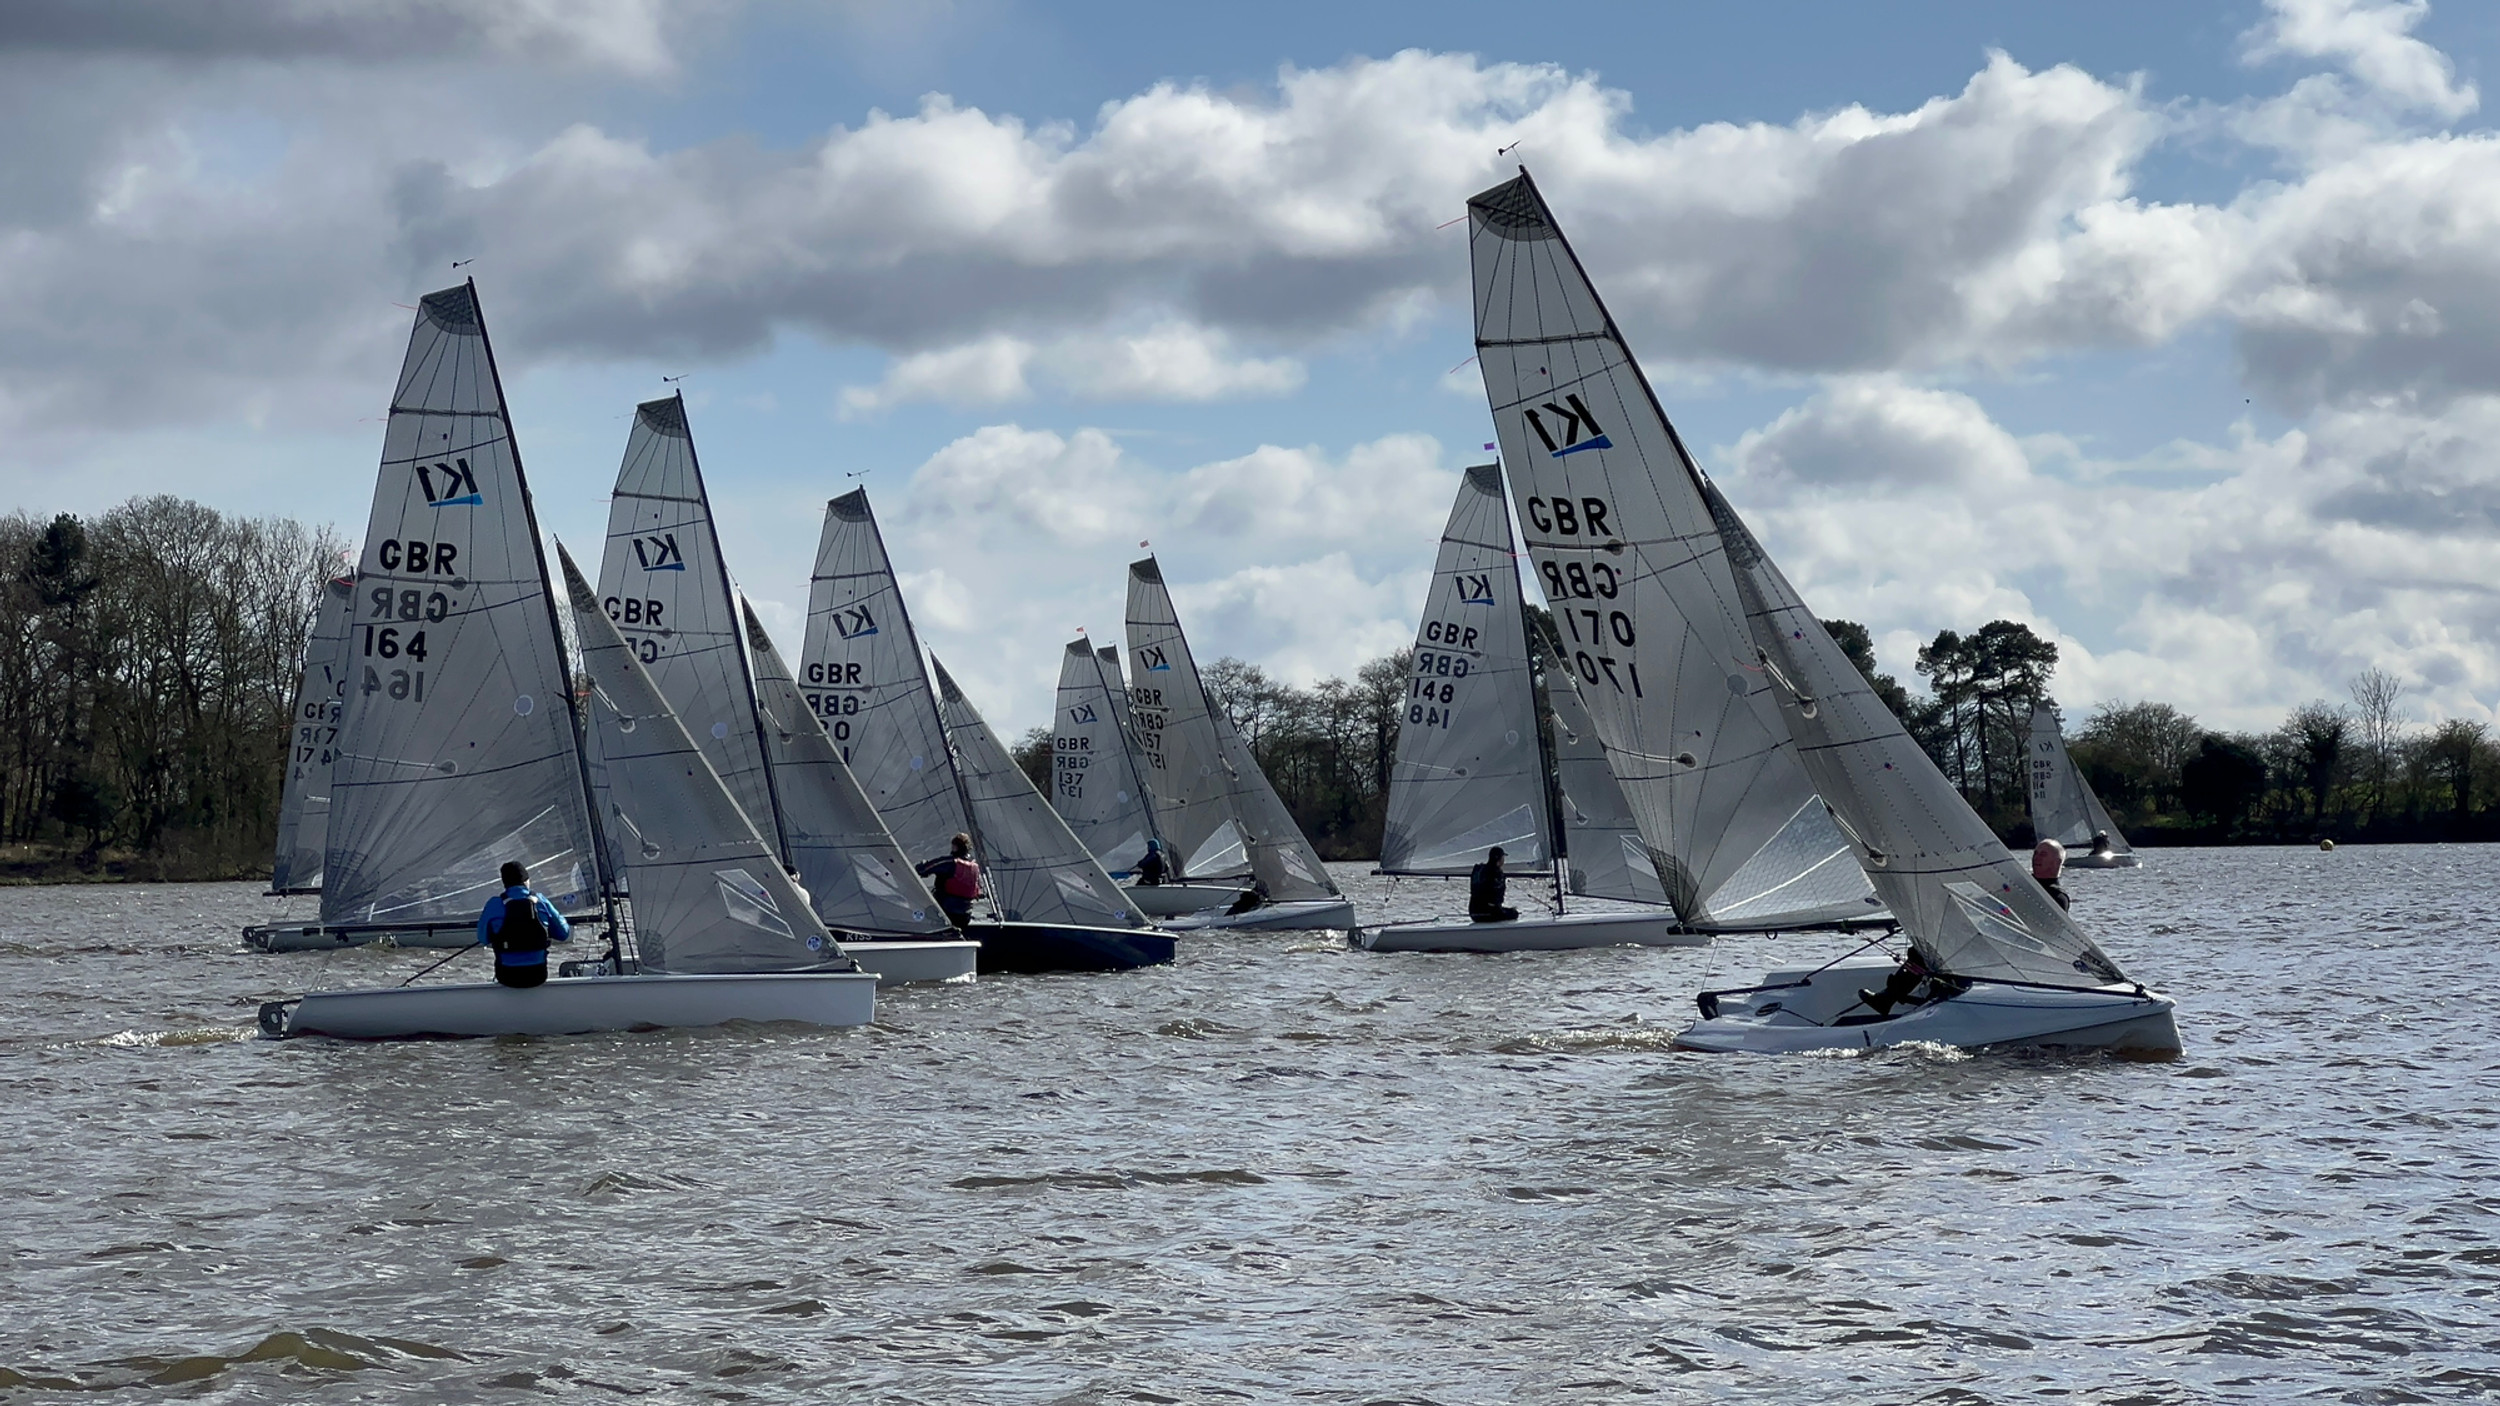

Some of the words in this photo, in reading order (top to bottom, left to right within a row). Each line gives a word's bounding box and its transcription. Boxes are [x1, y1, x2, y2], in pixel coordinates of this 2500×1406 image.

[1528, 496, 1613, 537] GBR
[379, 539, 457, 575] GBR
[604, 596, 664, 626] GBR
[1426, 621, 1478, 649] GBR
[1564, 607, 1636, 648] 170
[364, 626, 427, 662] 164
[808, 663, 861, 684] GBR
[1135, 688, 1162, 706] GBR
[1413, 678, 1454, 704] 148
[1057, 738, 1089, 750] GBR
[1059, 771, 1084, 785] 137
